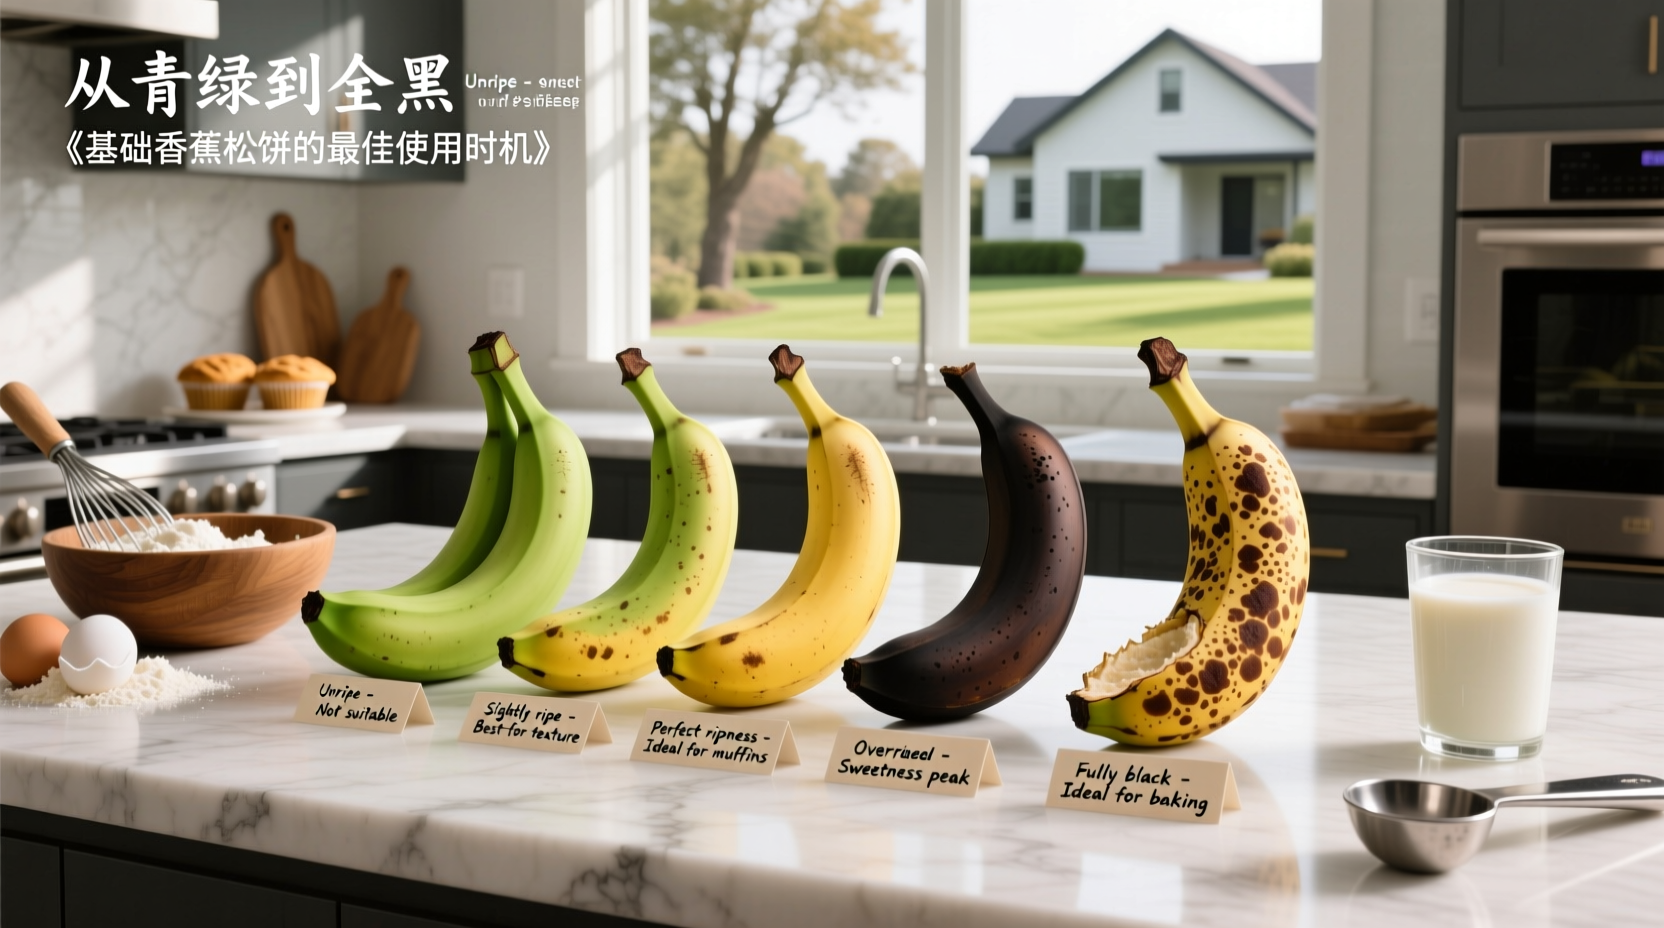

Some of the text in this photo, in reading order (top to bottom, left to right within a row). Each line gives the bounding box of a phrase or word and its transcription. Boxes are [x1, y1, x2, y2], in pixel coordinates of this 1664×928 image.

[319, 683, 361, 703] Unripe
[315, 702, 398, 722] Not suitable
[535, 708, 562, 726] ripe
[473, 719, 503, 735] Best
[507, 722, 527, 737] for
[650, 721, 702, 738] Perfect
[705, 726, 758, 745] ripness
[643, 738, 769, 763] Ideal for muffins
[837, 758, 970, 788] Sweetness peak
[1075, 762, 1118, 785] Fully
[1125, 765, 1172, 786] black
[1060, 782, 1209, 818] Ideal for baking
